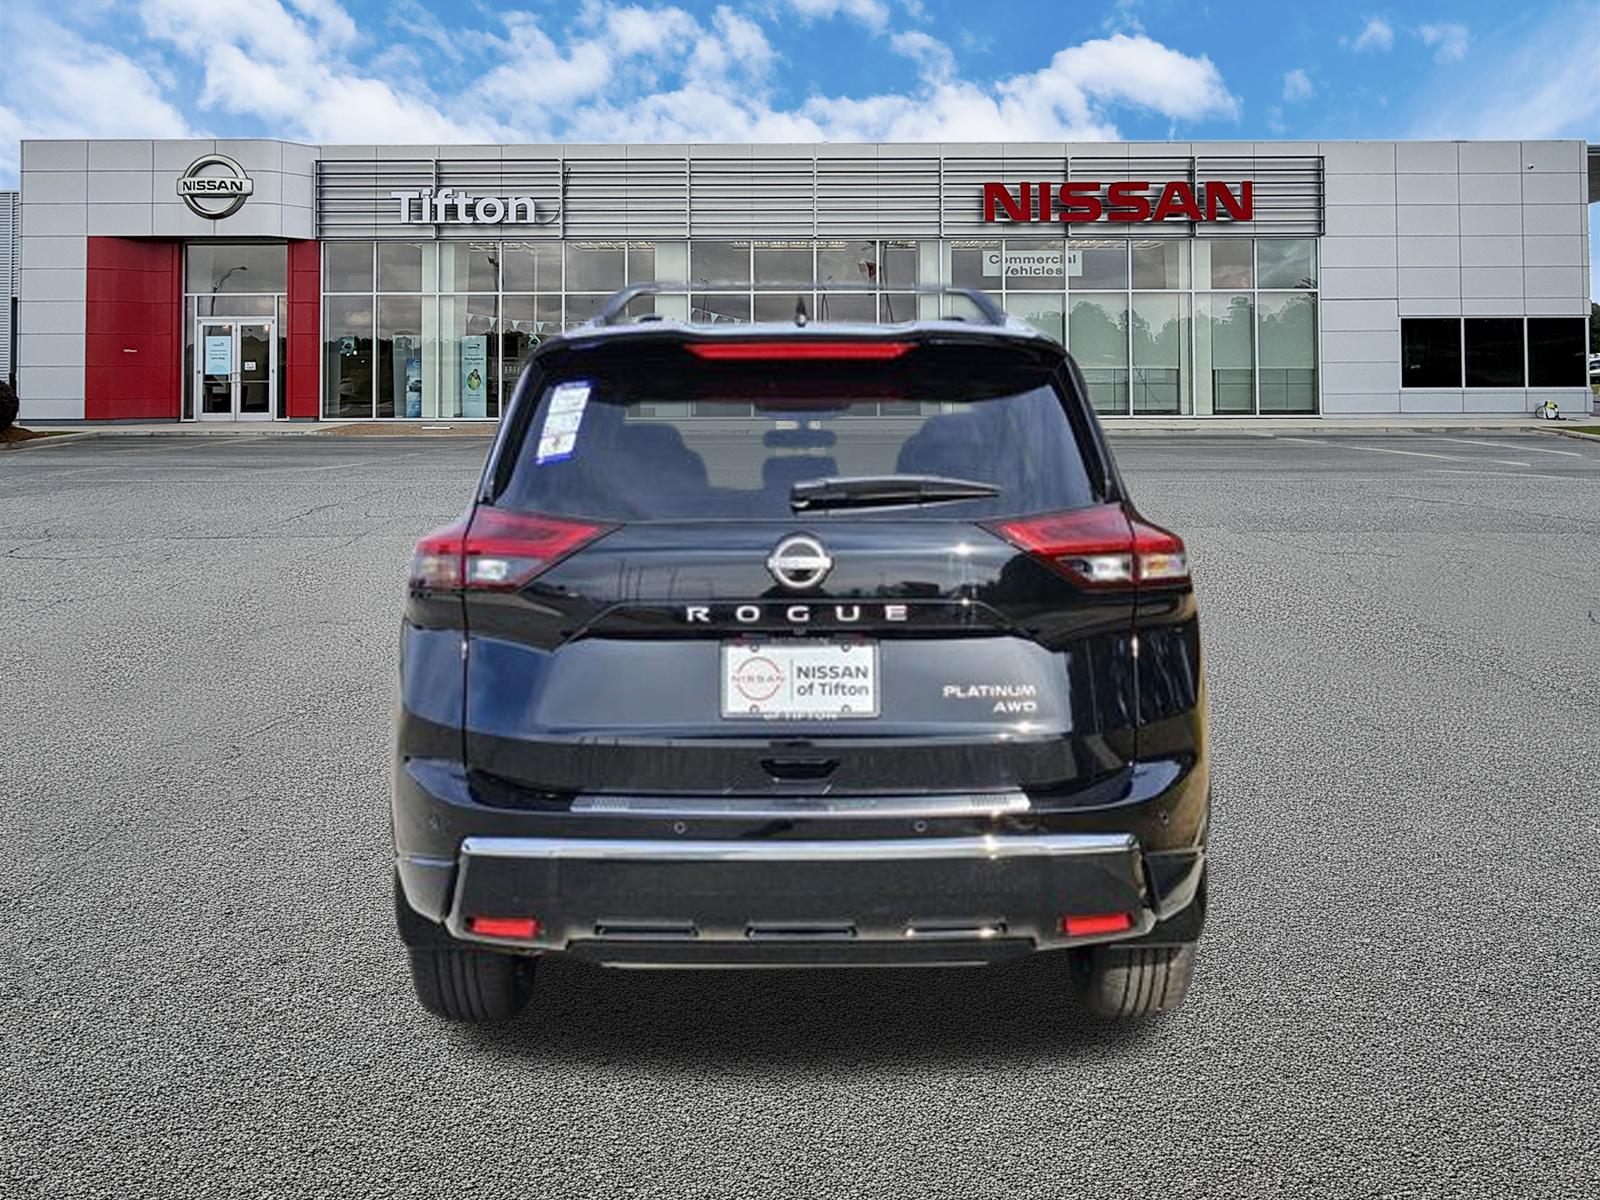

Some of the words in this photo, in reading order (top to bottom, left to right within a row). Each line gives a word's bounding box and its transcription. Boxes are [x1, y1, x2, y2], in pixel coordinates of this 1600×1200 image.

[183, 180, 243, 191] NISSAN
[391, 188, 536, 224] Tifton
[983, 180, 1253, 223] NISSAN
[686, 605, 907, 622] ROGUE
[796, 665, 869, 679] NISSAN
[797, 683, 815, 696] of
[819, 683, 869, 696] Tifton
[943, 685, 1036, 698] PLATINUM
[993, 701, 1037, 712] AWD
